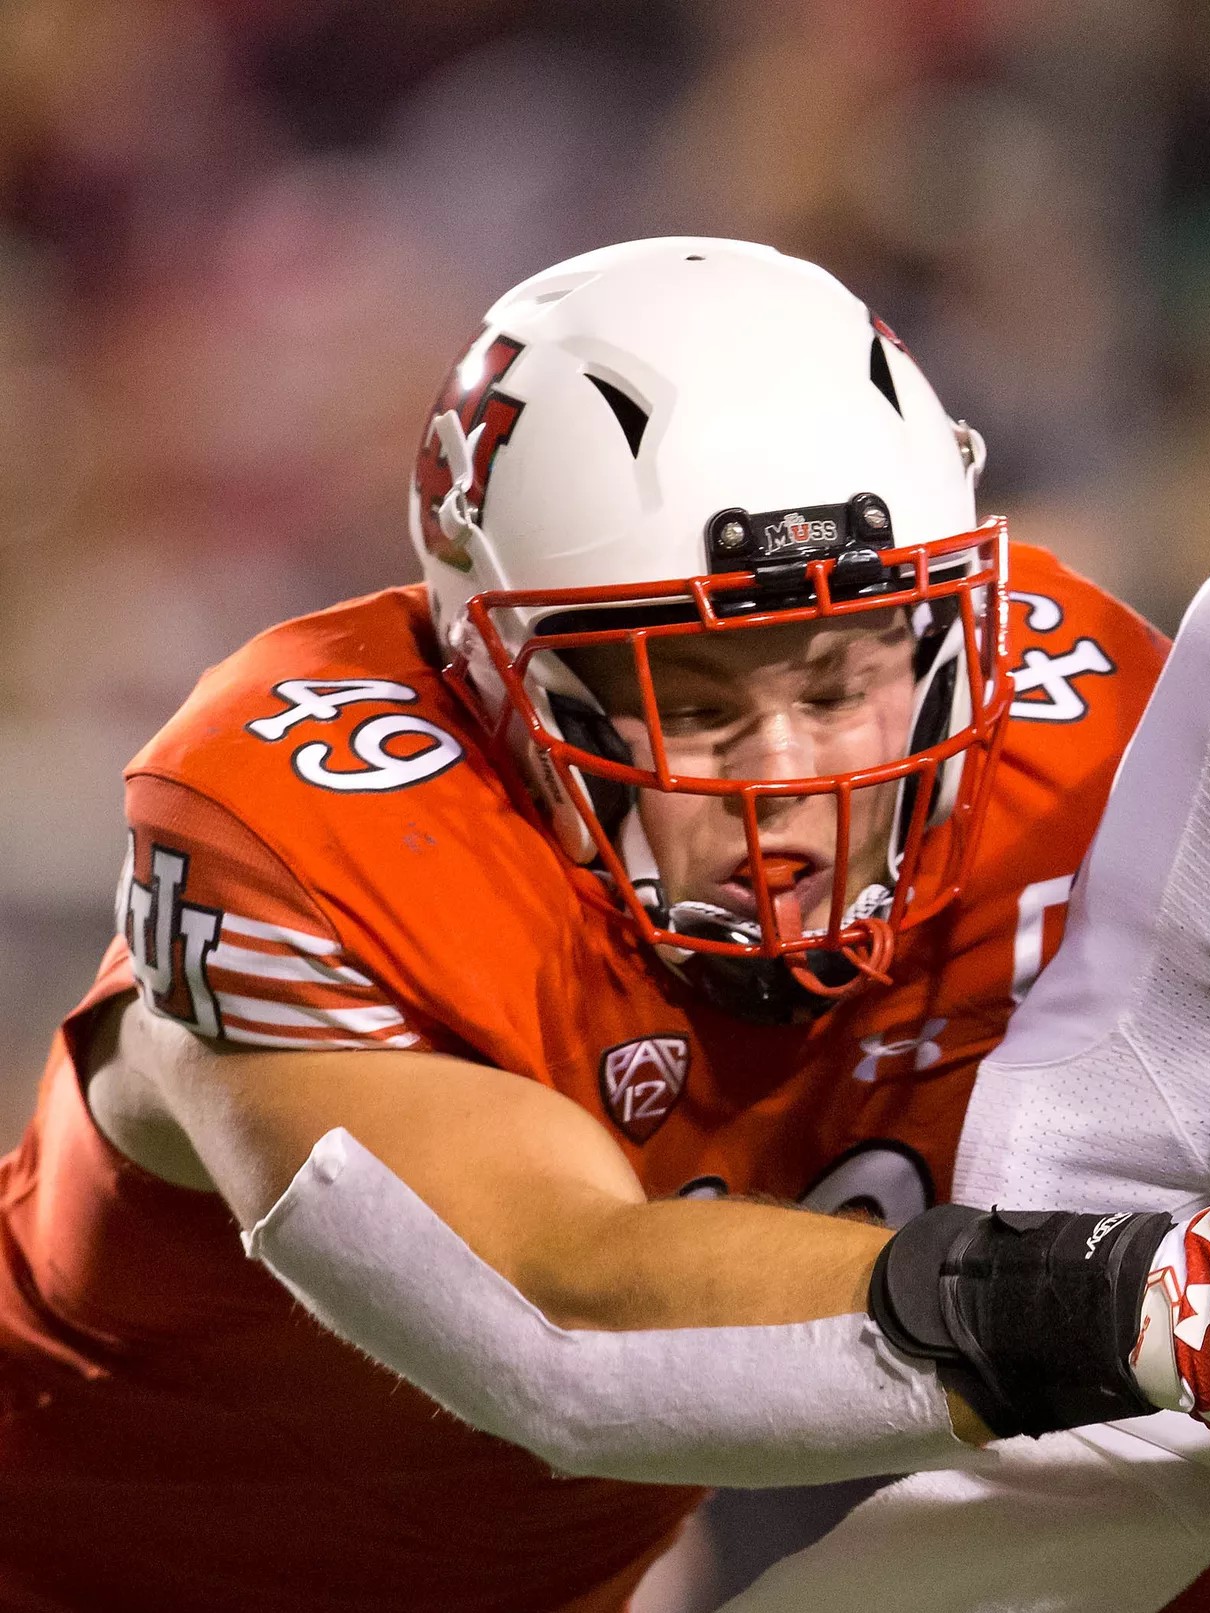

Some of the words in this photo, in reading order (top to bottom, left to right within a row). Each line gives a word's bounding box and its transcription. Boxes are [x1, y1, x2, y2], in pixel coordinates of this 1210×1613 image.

[244, 678, 467, 794] 49
[605, 1038, 687, 1105] PAC
[623, 1080, 667, 1122] 12
